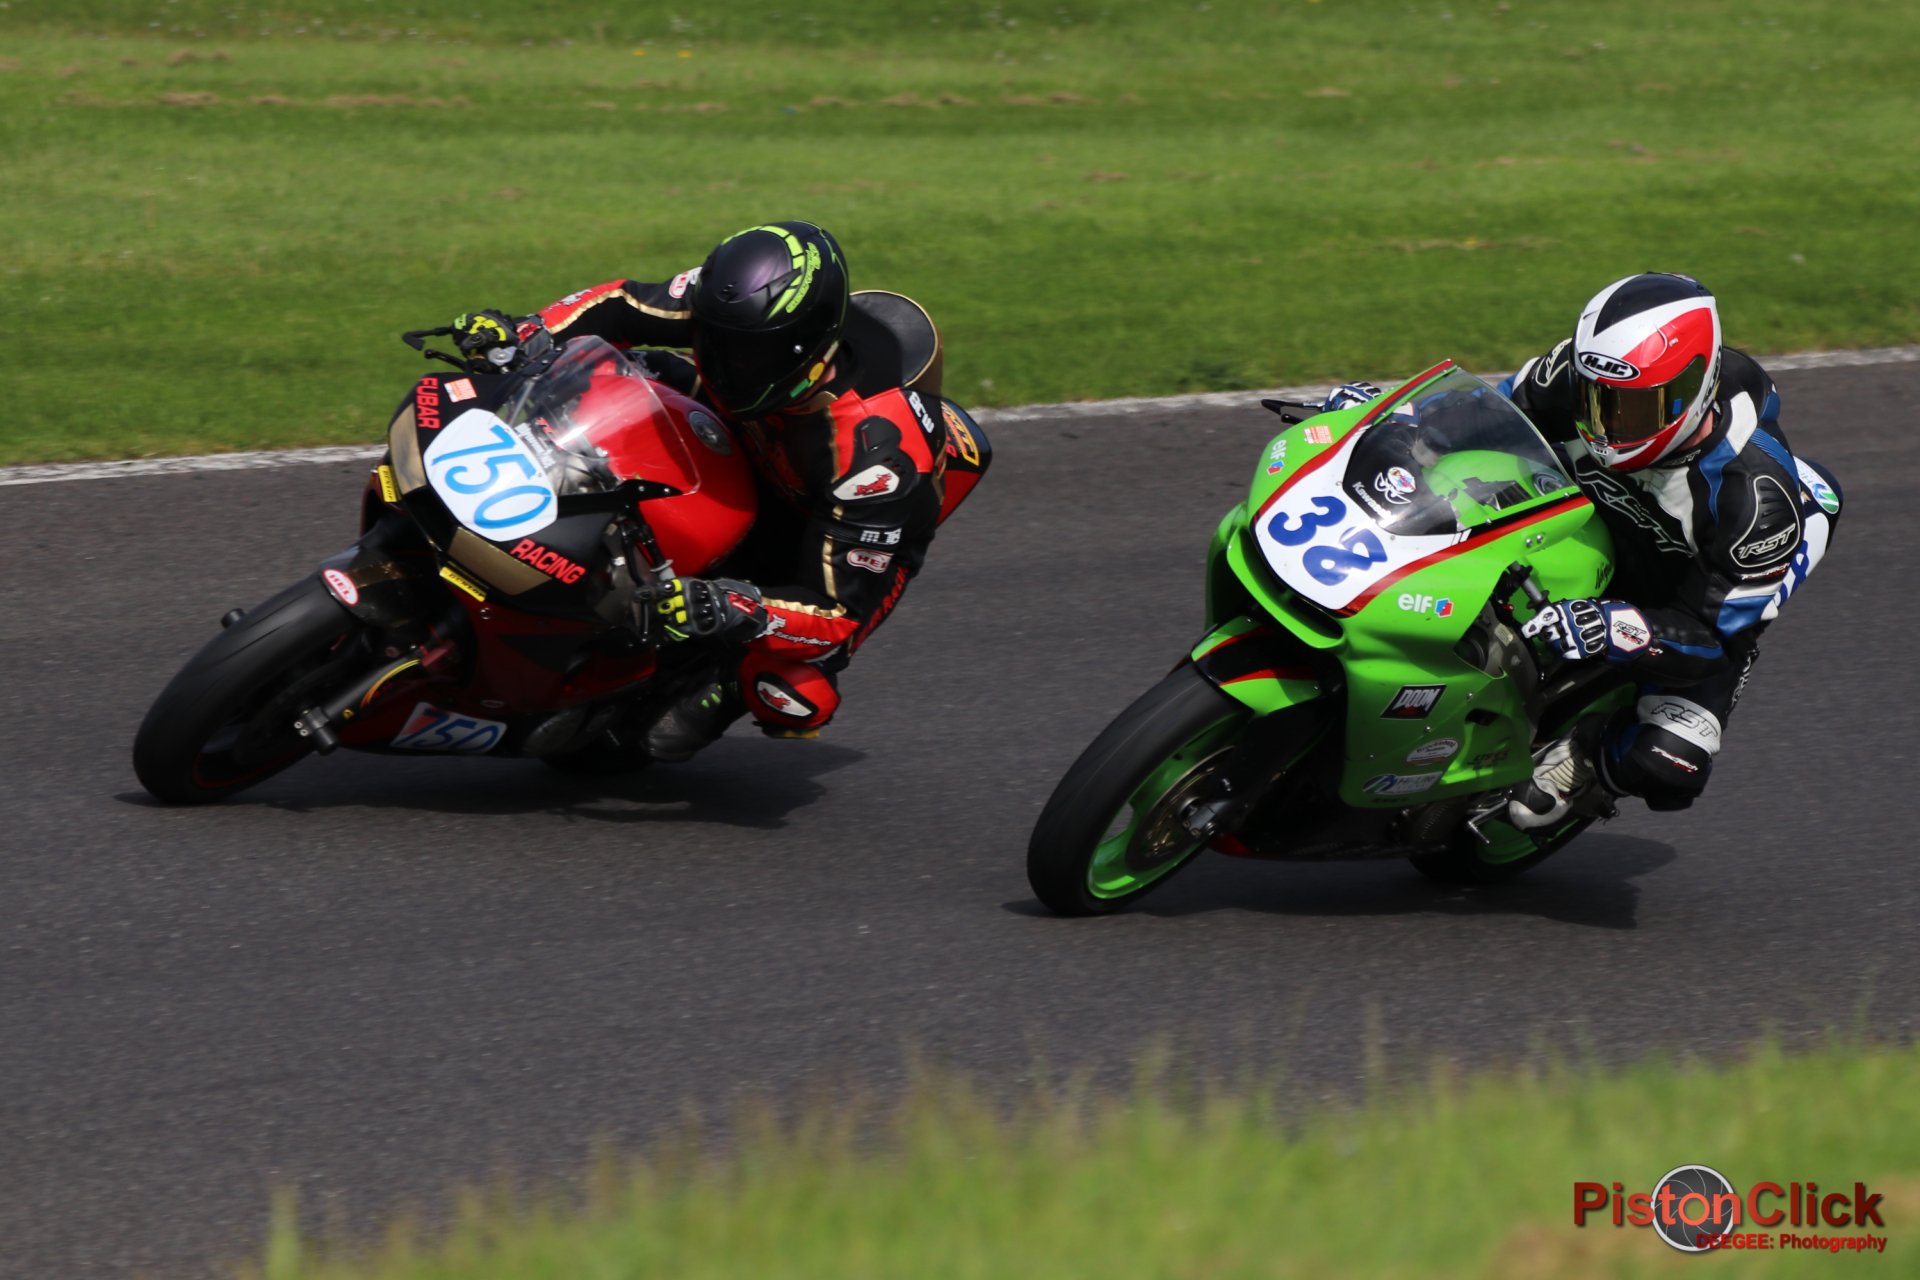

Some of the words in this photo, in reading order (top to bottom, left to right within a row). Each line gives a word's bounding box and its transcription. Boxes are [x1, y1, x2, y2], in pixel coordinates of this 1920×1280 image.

[1583, 354, 1629, 377] HJC
[416, 377, 441, 430] FUBAR
[1270, 439, 1287, 461] elf
[431, 424, 552, 530] 750
[1268, 495, 1389, 586] 38
[1738, 522, 1797, 560] RST
[509, 538, 588, 585] RACING
[1398, 593, 1433, 614] elf
[1392, 688, 1441, 711] DOOM
[393, 707, 500, 754] 750
[1650, 702, 1719, 738] RST
